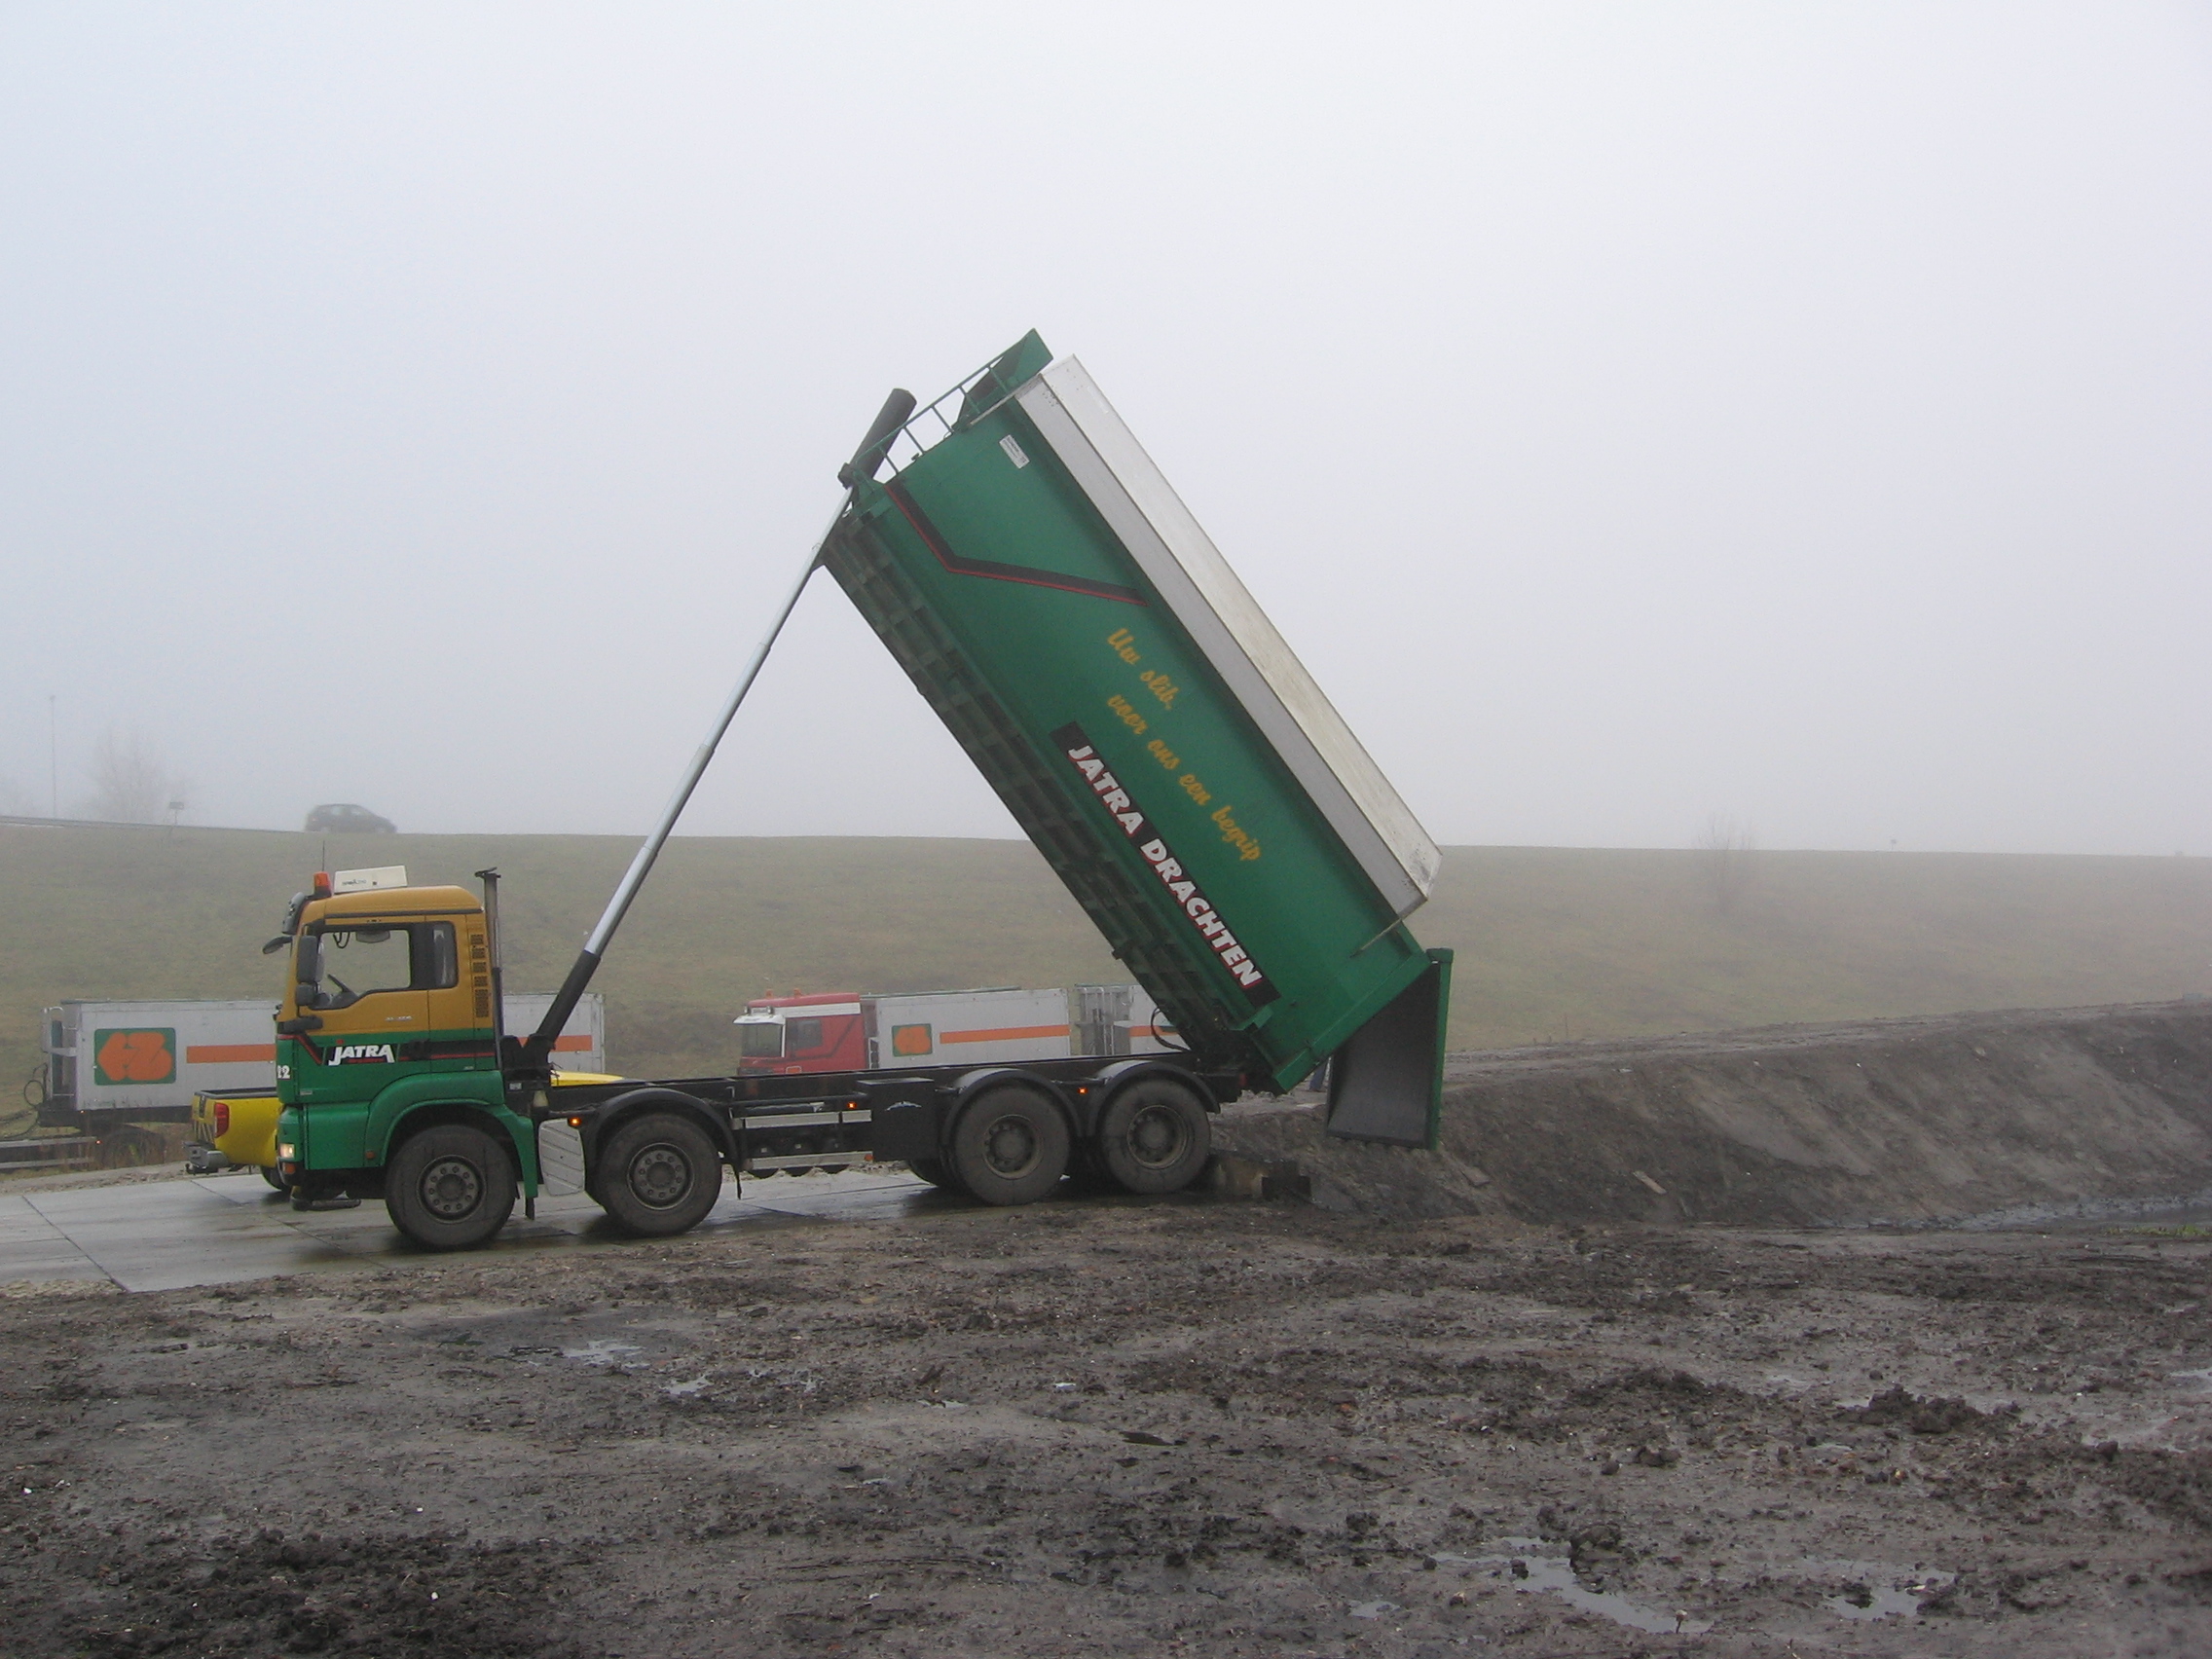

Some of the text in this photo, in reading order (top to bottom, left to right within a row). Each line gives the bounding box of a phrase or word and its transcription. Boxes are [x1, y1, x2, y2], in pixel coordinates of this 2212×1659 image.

[1107, 628, 1141, 664] Uw
[1107, 694, 1261, 861] voor ons een begrip
[1067, 745, 1263, 987] JATRA DRACHTEN
[328, 1044, 395, 1066] JATRA
